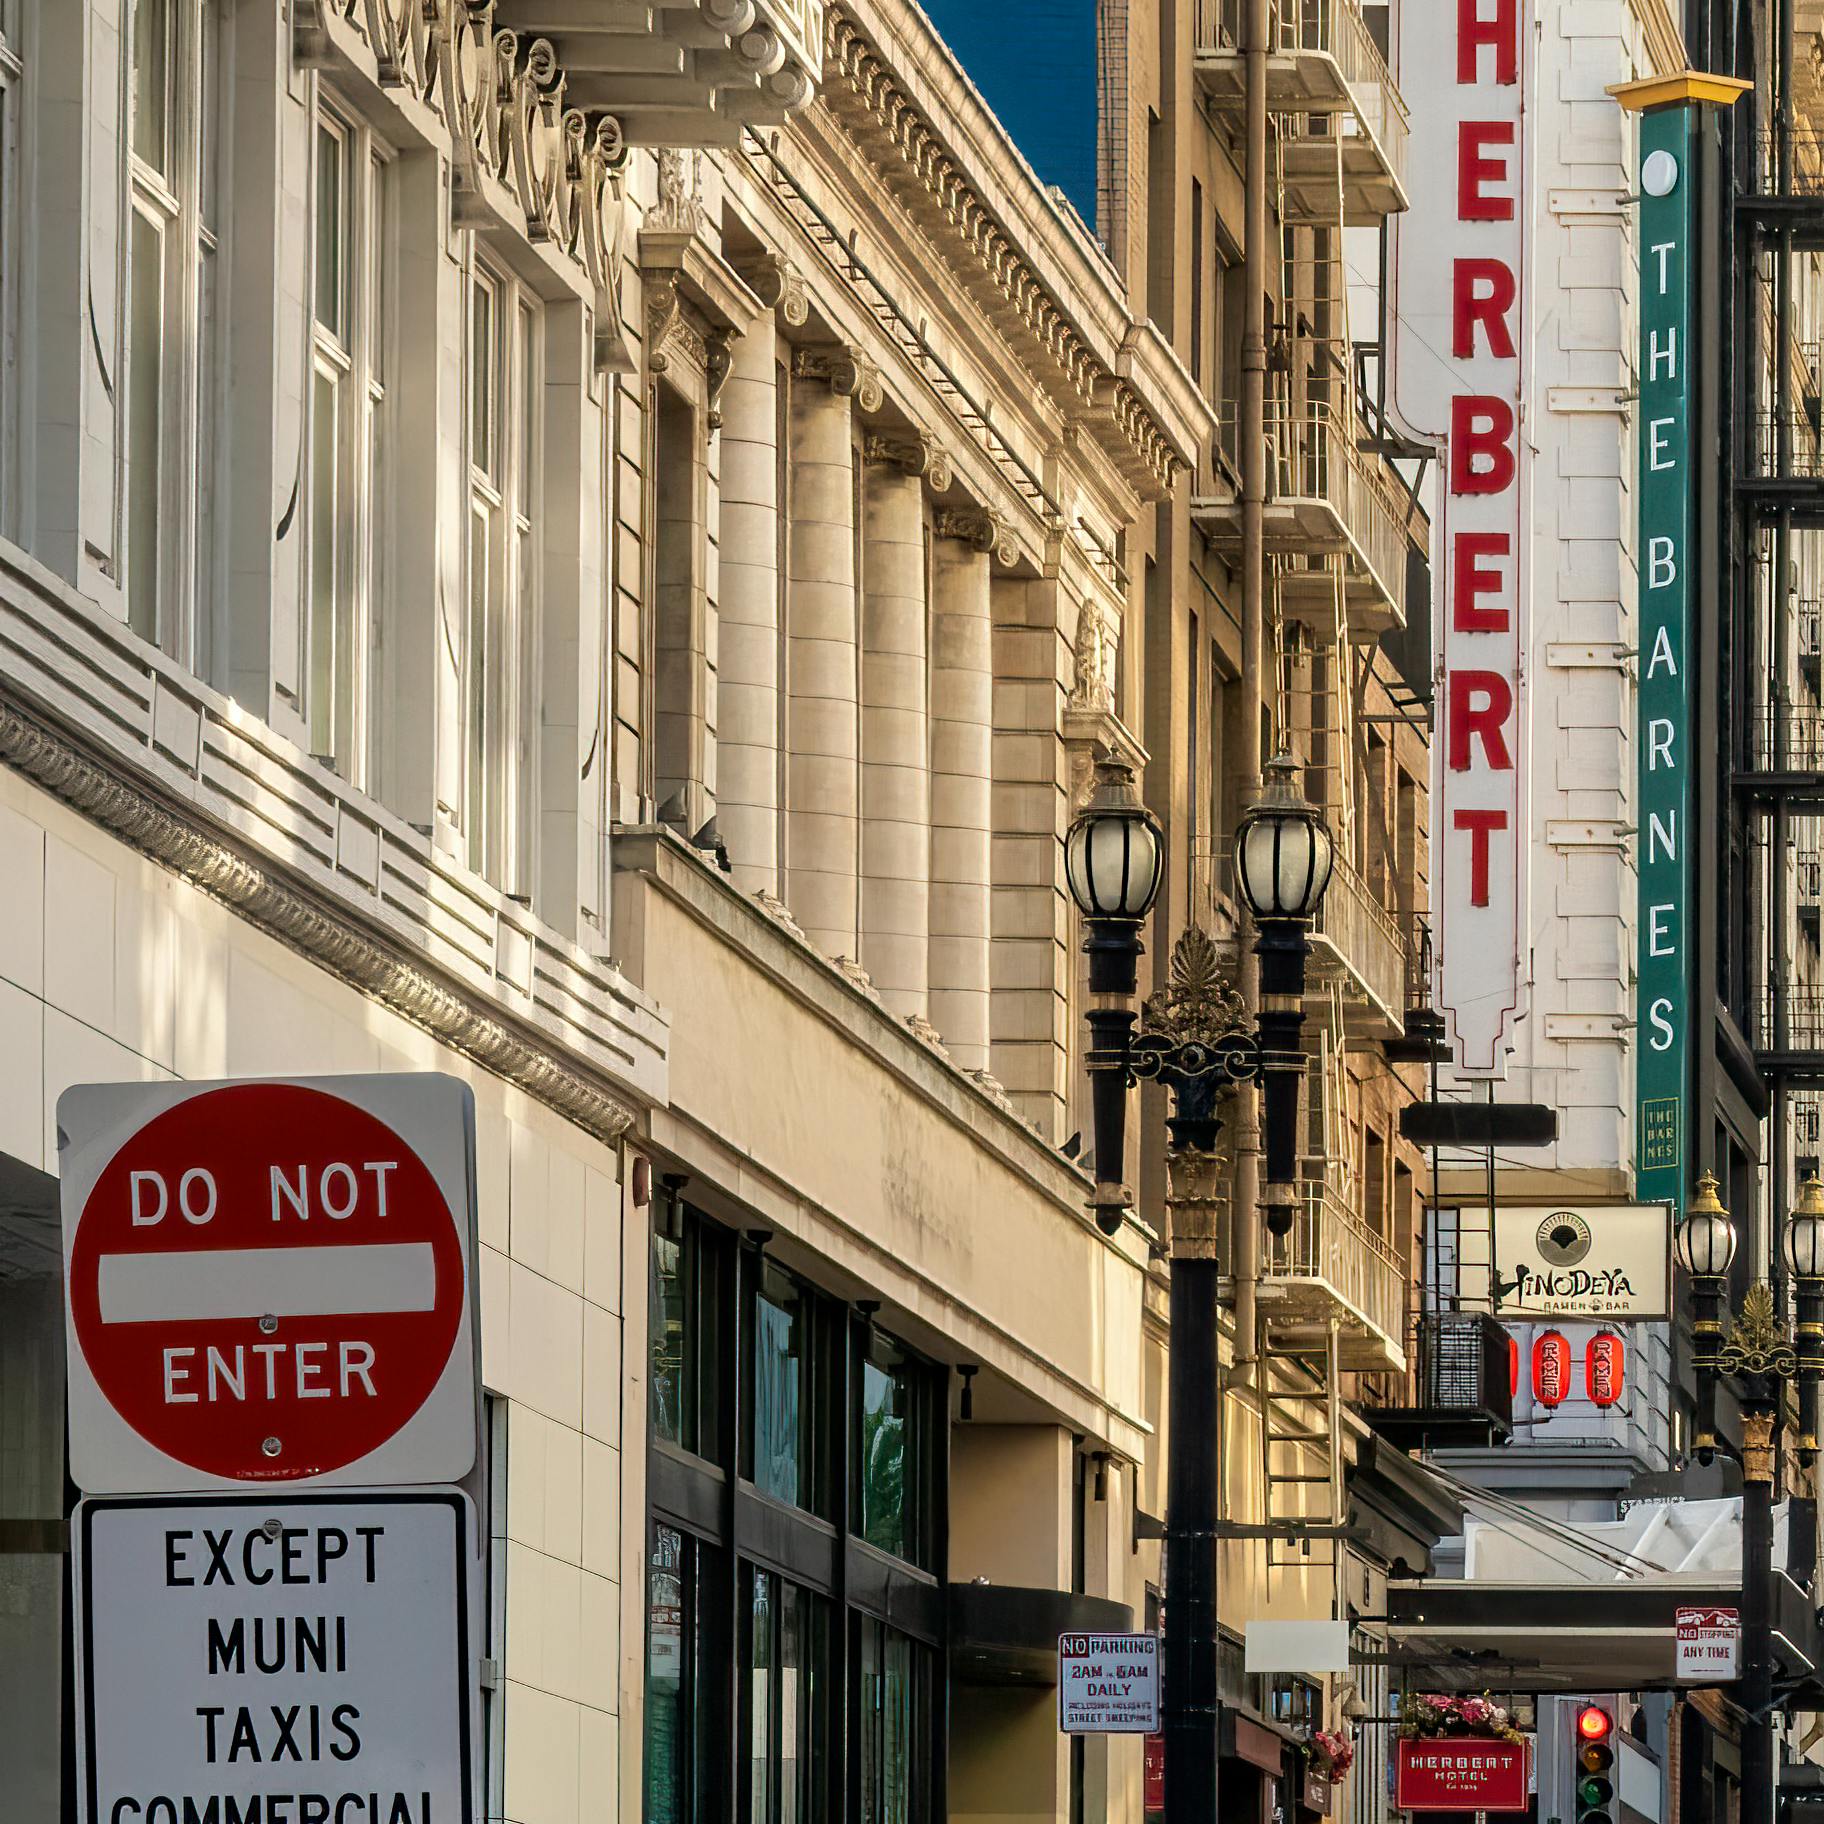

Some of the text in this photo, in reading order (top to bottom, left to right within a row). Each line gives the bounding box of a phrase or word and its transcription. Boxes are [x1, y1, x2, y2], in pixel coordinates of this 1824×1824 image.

[1450, 0, 1516, 907] HERBERT
[1647, 241, 1677, 1052] THE BARNES
[130, 1161, 398, 1227] DO NOT
[164, 1341, 377, 1404] ENTER
[166, 1527, 385, 1586] EXCEPT
[208, 1615, 346, 1675] MUNI
[1062, 1638, 1154, 1655] NO PARKING
[1679, 1629, 1697, 1638] NO
[1087, 1683, 1132, 1696] DAILY
[196, 1704, 361, 1764] TAXIS
[1410, 1756, 1513, 1769] HERBERT
[1435, 1771, 1488, 1781] HOTEL
